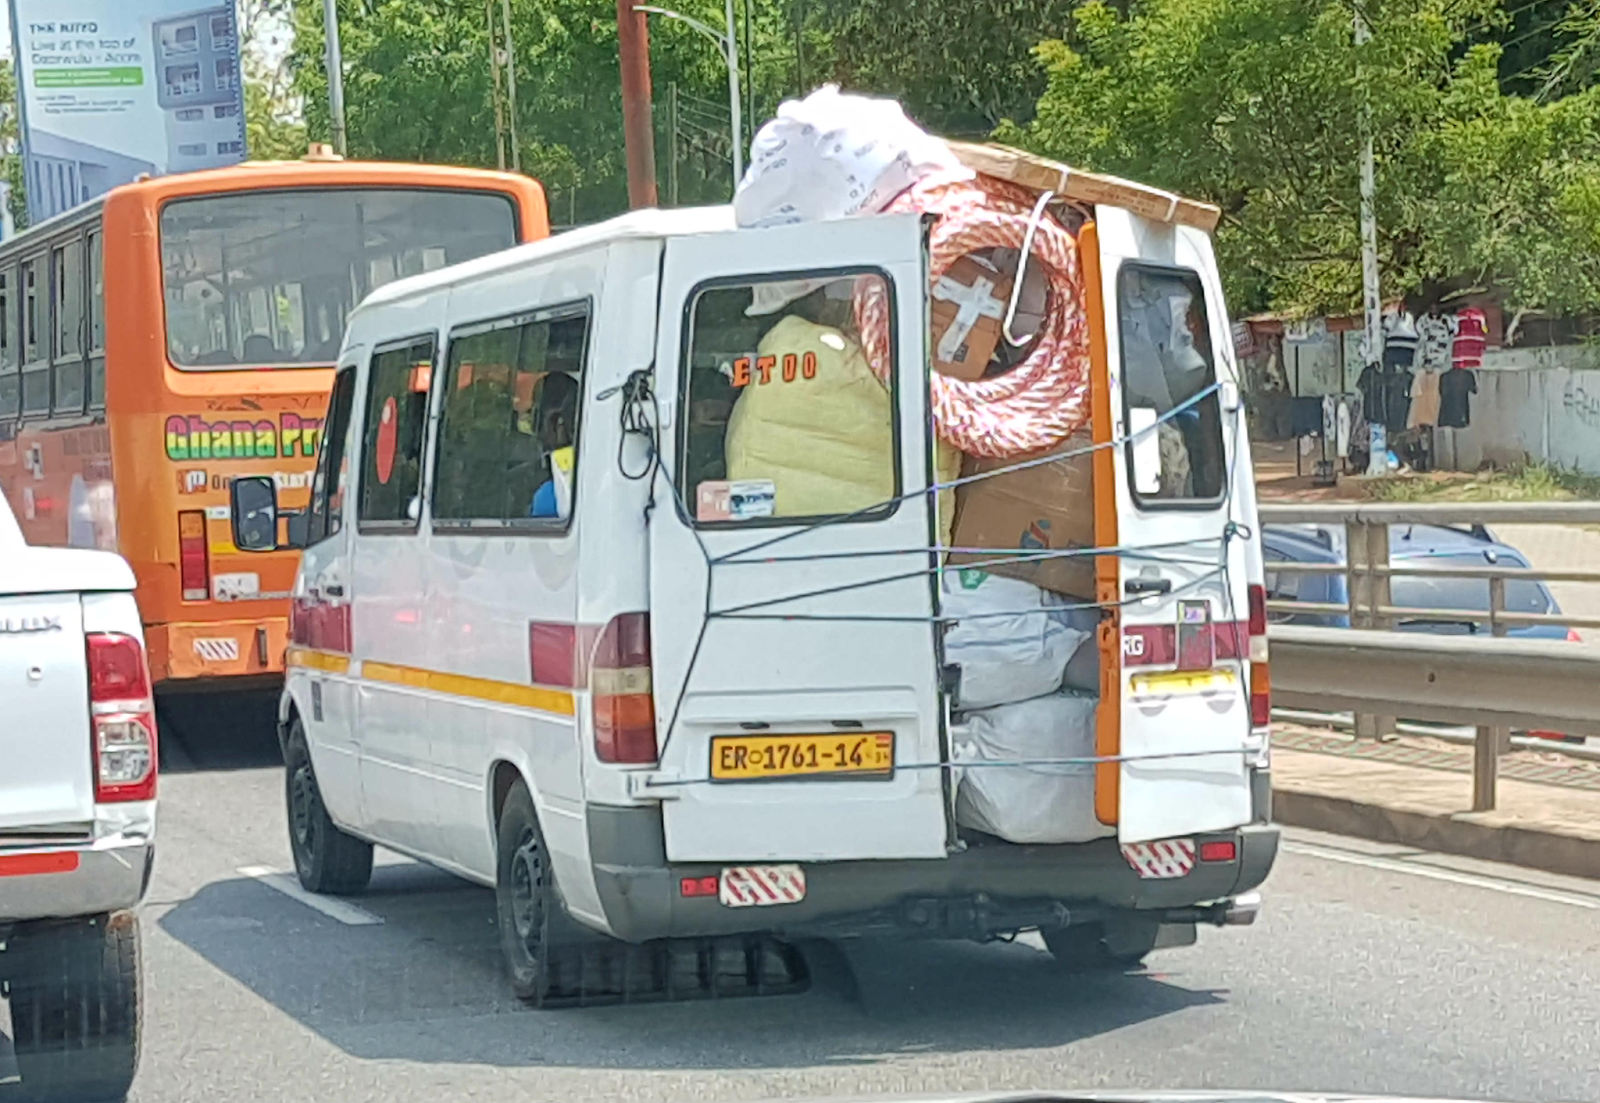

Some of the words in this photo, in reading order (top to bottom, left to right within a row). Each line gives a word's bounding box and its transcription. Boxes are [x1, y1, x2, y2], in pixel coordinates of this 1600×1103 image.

[29, 22, 56, 35] THE
[123, 36, 135, 49] of
[165, 414, 277, 461] Ghana
[720, 745, 748, 770] ER
[762, 737, 868, 769] 1761-14
